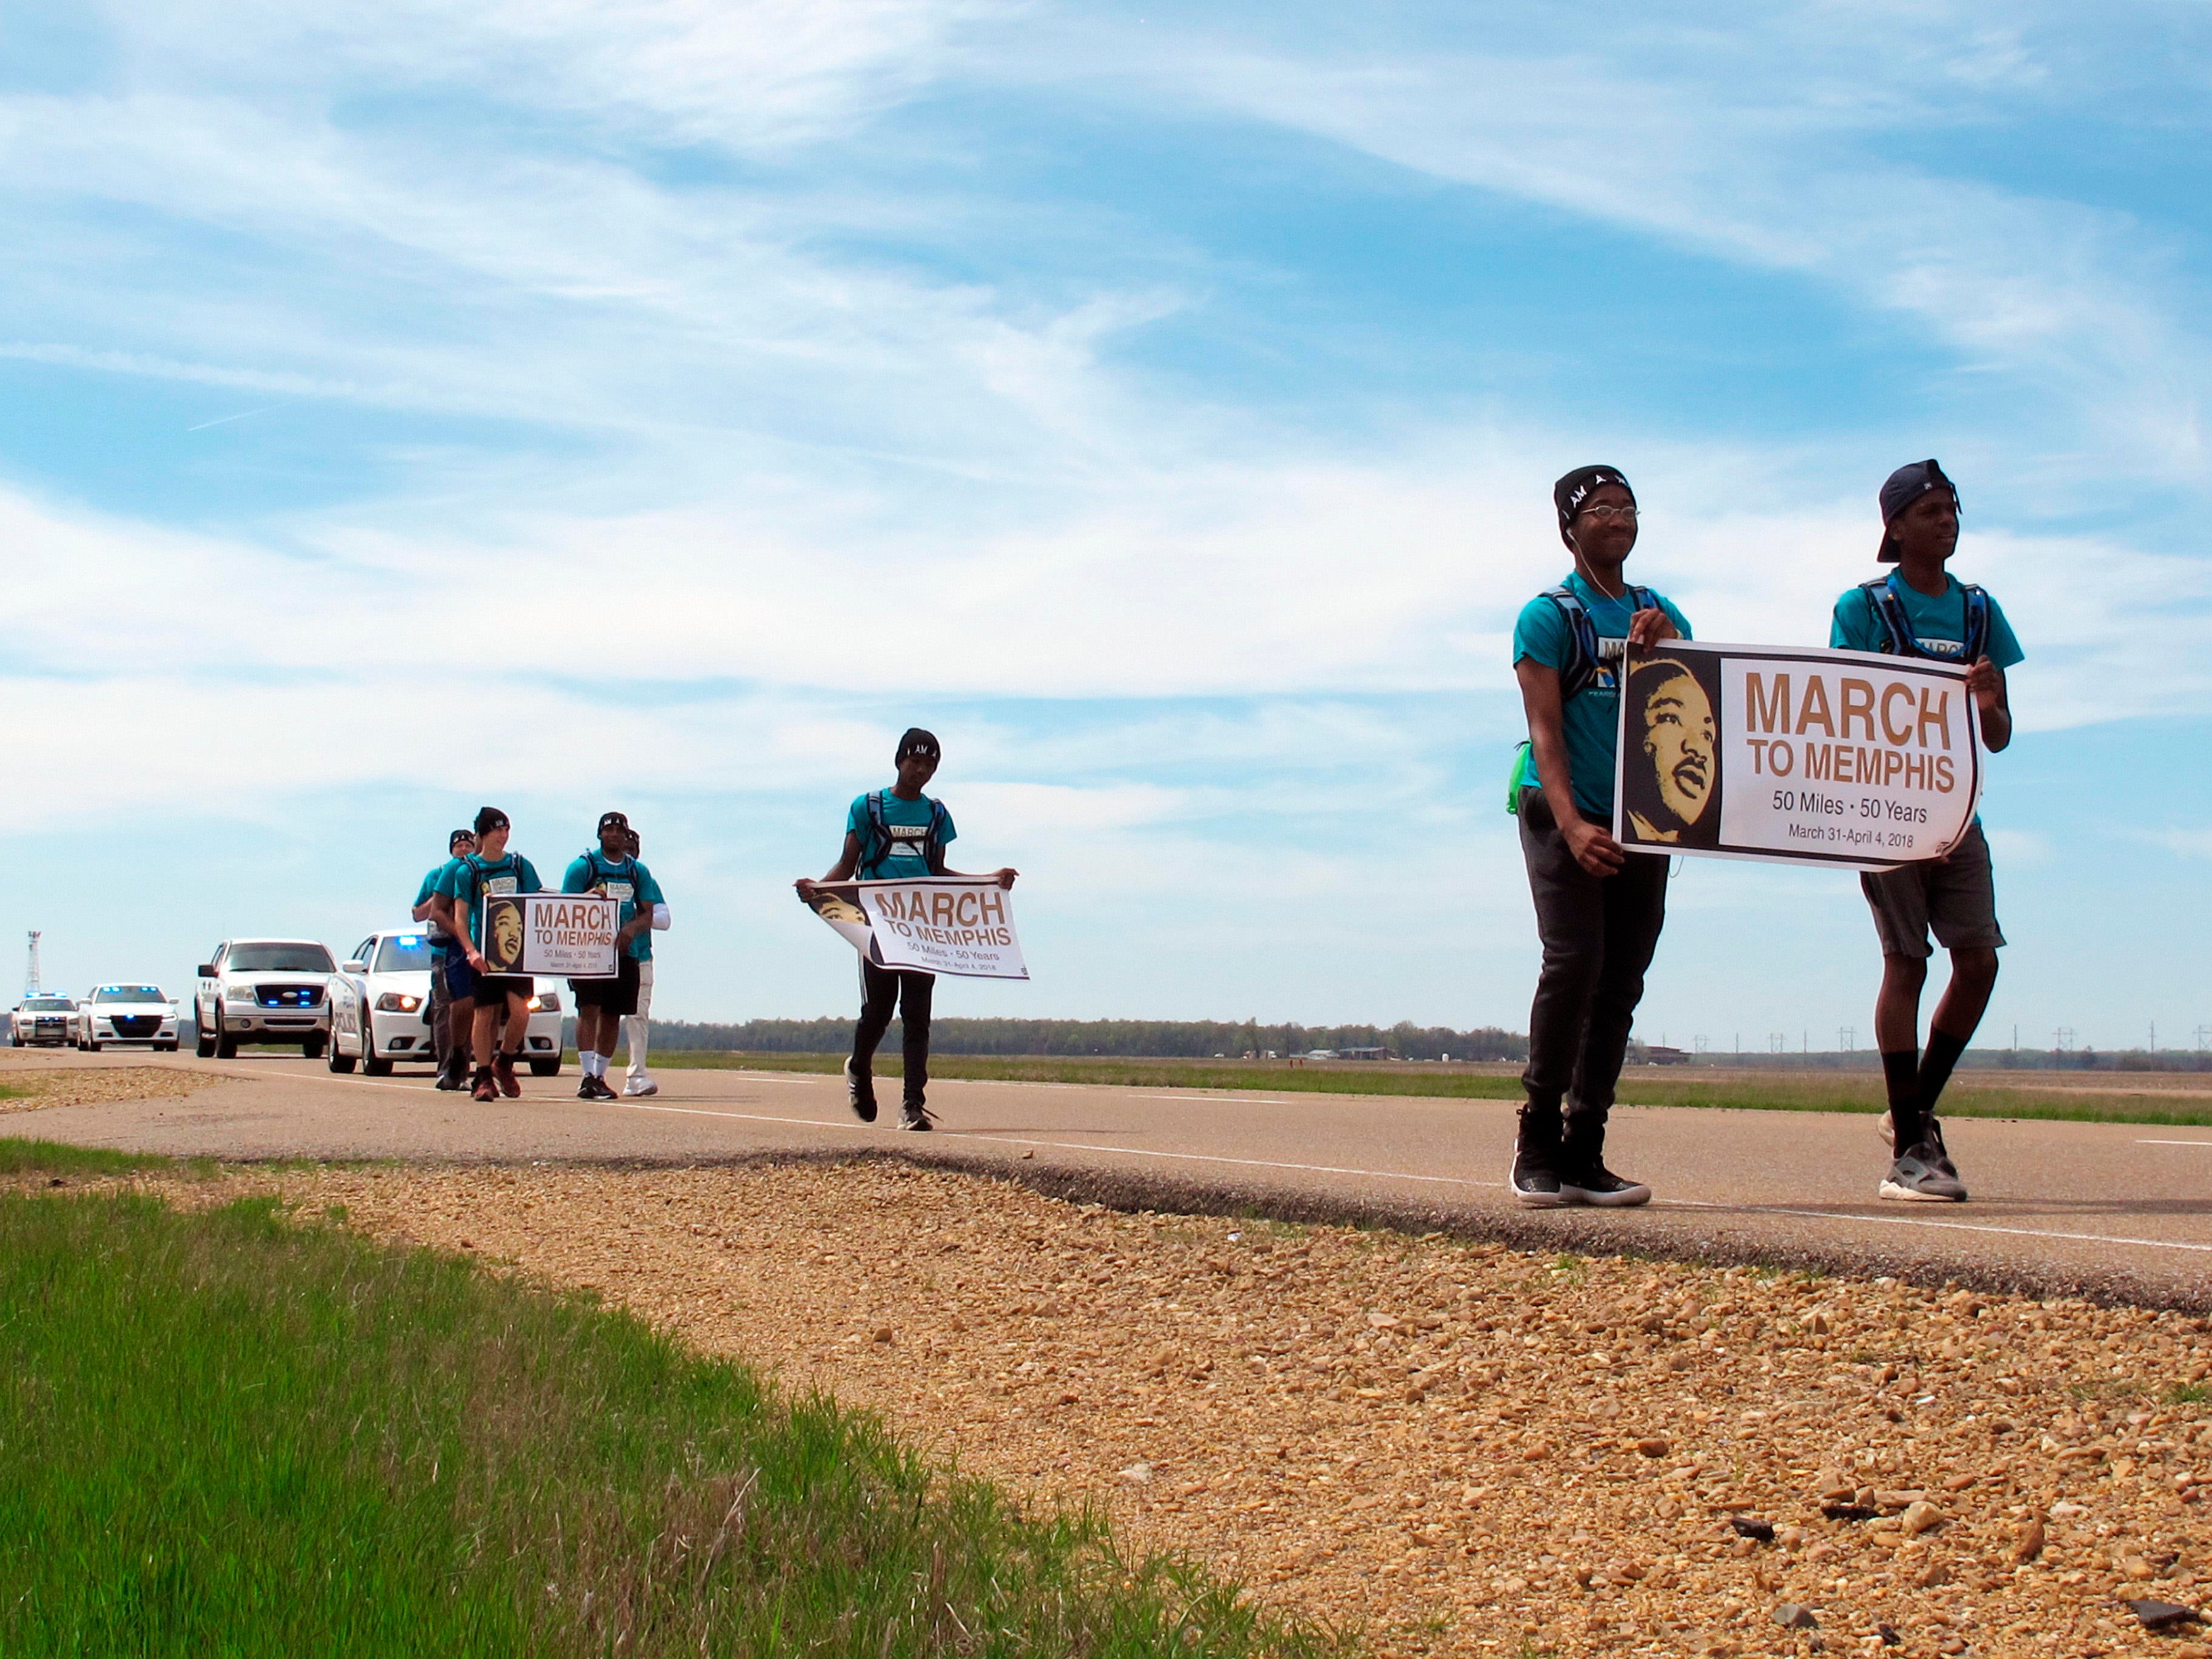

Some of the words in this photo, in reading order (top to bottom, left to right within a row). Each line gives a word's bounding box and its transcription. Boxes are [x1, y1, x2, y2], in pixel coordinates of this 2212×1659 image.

[1570, 485, 1587, 509] AM
[1595, 474, 1607, 484] A
[1746, 672, 1951, 750] MARCH
[914, 744, 928, 754] AM
[1746, 739, 1794, 777] TO
[1805, 742, 1955, 793] MEMPHIS
[1772, 790, 1794, 811] 50
[1800, 791, 1844, 815] Miles
[1859, 798, 1881, 819] 50
[1885, 799, 1928, 823] Years
[1789, 823, 1825, 840] March
[1828, 826, 1872, 846] 31-April
[1875, 831, 1885, 847] 4,
[1888, 833, 1914, 848] 2018
[535, 903, 612, 930] MARCH
[874, 891, 1006, 927] MARCH
[535, 930, 552, 944] TO
[557, 930, 612, 946] MEMPHIS
[883, 919, 912, 937] TO
[916, 925, 1011, 947] MEMPHIS
[907, 941, 920, 952] 50
[956, 950, 968, 960] 50
[970, 950, 1000, 961] Years
